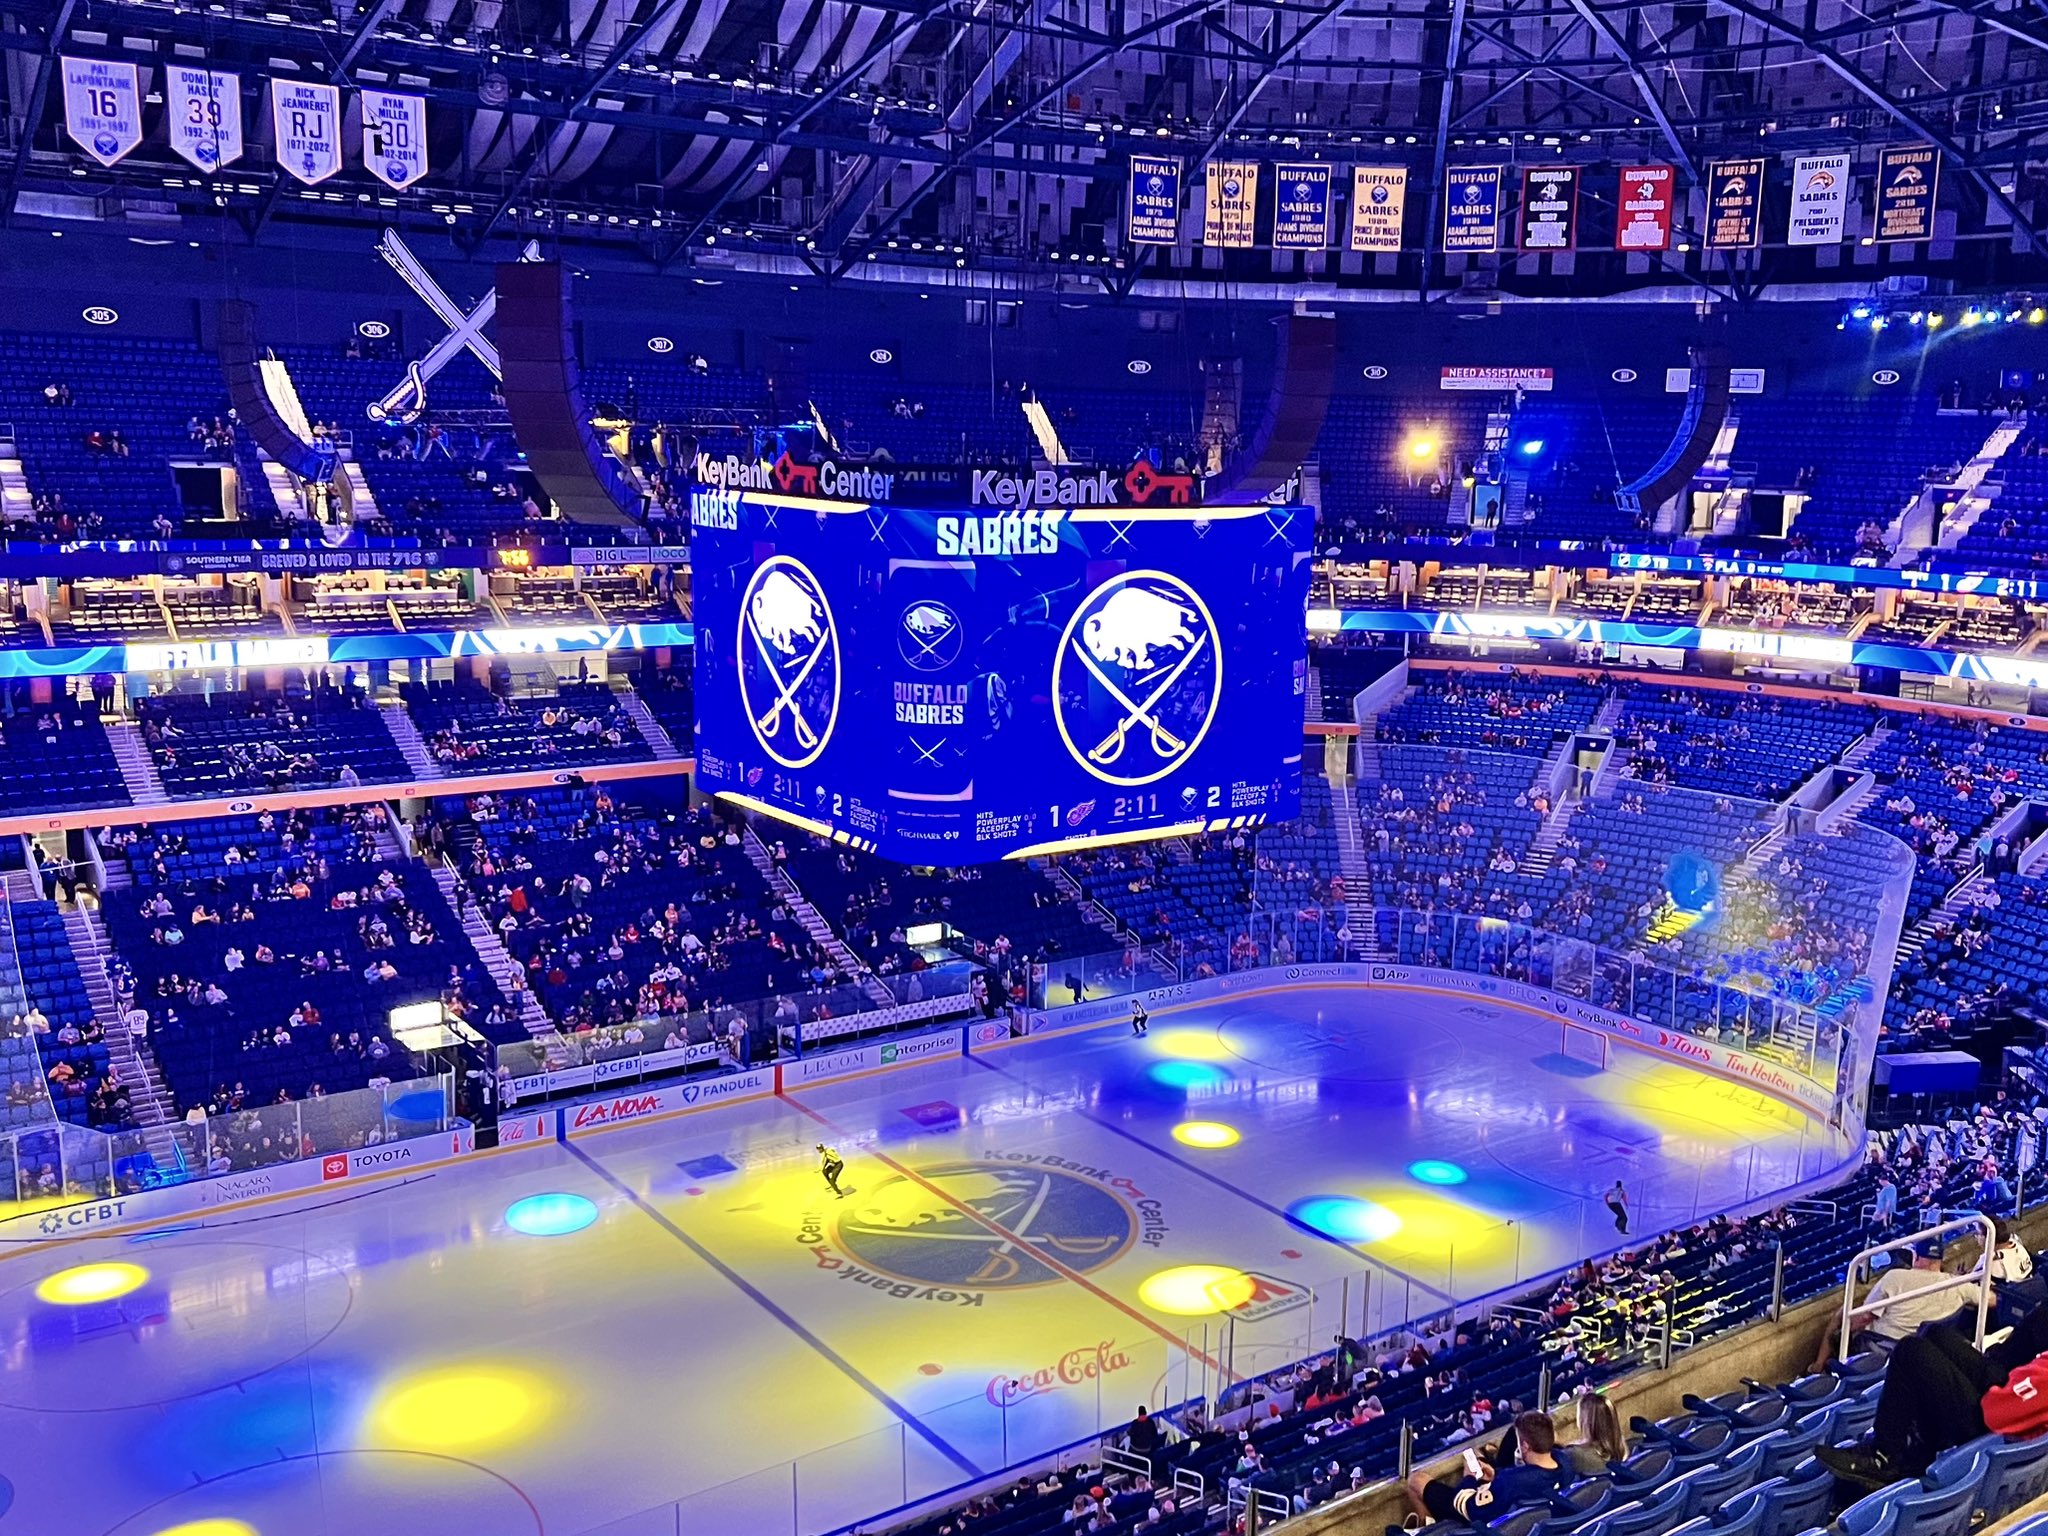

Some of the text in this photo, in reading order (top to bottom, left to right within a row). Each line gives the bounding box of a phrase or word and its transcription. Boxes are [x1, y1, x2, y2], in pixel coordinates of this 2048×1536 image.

[91, 64, 108, 75] PAT
[188, 84, 219, 98] HASK
[295, 87, 315, 99] RICK
[88, 89, 117, 117] 16
[282, 98, 331, 113] JEANNERET
[382, 97, 404, 109] RYAN
[188, 98, 221, 127] 39
[379, 108, 409, 121] MILLER
[292, 112, 322, 138] RJ
[381, 121, 408, 148] 30
[287, 138, 330, 152] 1971-2022
[1801, 159, 1843, 170] BUFFALO
[1887, 152, 1932, 165] BUFFALO
[1135, 163, 1177, 176] BUFFALO
[1280, 171, 1326, 182] BUFFALO
[1358, 174, 1403, 185] BUFFALO
[1450, 173, 1496, 184] BUFFALO
[1800, 192, 1838, 202] SABRES
[1886, 185, 1927, 198] SABRES
[1136, 195, 1174, 208] SABRES
[1281, 202, 1322, 213] SABRES
[1359, 205, 1399, 216] SABRES
[1451, 204, 1492, 216] SABRES
[1277, 223, 1298, 232] ADAMS
[1713, 217, 1751, 227] ORTHEST
[1133, 226, 1175, 239] CHAMPIONS
[1354, 225, 1372, 235] PRINCE
[1375, 226, 1382, 235] OF
[1801, 228, 1830, 236] TROPHY
[1277, 233, 1323, 244] CHAMPIONS
[1353, 236, 1399, 247] CHAMPIONS
[1447, 236, 1493, 246] CHAMPIONS
[92, 311, 109, 320] 305
[367, 325, 382, 335] 306
[654, 341, 668, 349] 307
[1449, 368, 1546, 378] NEED ASSISTANCE?
[697, 452, 894, 500] KeyBank Center
[972, 469, 1118, 507] KeyBank
[937, 517, 1058, 555] SABRES
[186, 556, 231, 564] SOUTHERN
[262, 552, 422, 568] BREWED & LOVED IN THE 716
[595, 549, 617, 560] BIG
[621, 549, 627, 560] L
[653, 548, 687, 559] NOCO
[1715, 560, 1740, 573] FLA
[1941, 573, 1950, 591] 1
[1997, 578, 2038, 598] 2:11
[894, 681, 968, 704] BUFFALO
[895, 702, 964, 725] SABRES
[738, 762, 744, 782] 1
[773, 773, 800, 799] 2:11
[1232, 784, 1269, 795] POWERPLAY
[1207, 787, 1220, 807] 2
[1232, 792, 1260, 802] FACEOFF
[1245, 799, 1265, 807] SHOTS
[833, 793, 842, 817] 2
[1114, 793, 1157, 816] 2:11
[976, 811, 994, 820] HITS
[976, 815, 1022, 827] POWERPLAY
[1050, 805, 1059, 827] 1
[976, 824, 1010, 834] FACEOFF
[976, 830, 1017, 841] BLK SHOTS
[1508, 985, 1537, 1001] BFLO
[1577, 1008, 1617, 1028] KeyBank
[609, 1059, 640, 1073] CFBT
[802, 1051, 865, 1076] LECOM
[1725, 1052, 1796, 1092] Tim Hortons
[515, 1075, 547, 1091] CFBT
[703, 1075, 762, 1098] FANDUEL
[574, 1105, 609, 1128] LA
[610, 1095, 661, 1117] NOVA
[354, 1148, 411, 1167] TOYOTA
[216, 1175, 271, 1191] NIAGARA
[216, 1185, 271, 1202] UNIVERSITY
[984, 1149, 1169, 1249] KeyBank Center
[67, 1201, 126, 1226] CFBT
[796, 1205, 984, 1308] KeyBank Cent
[986, 1338, 1131, 1408] Coca-Cola
